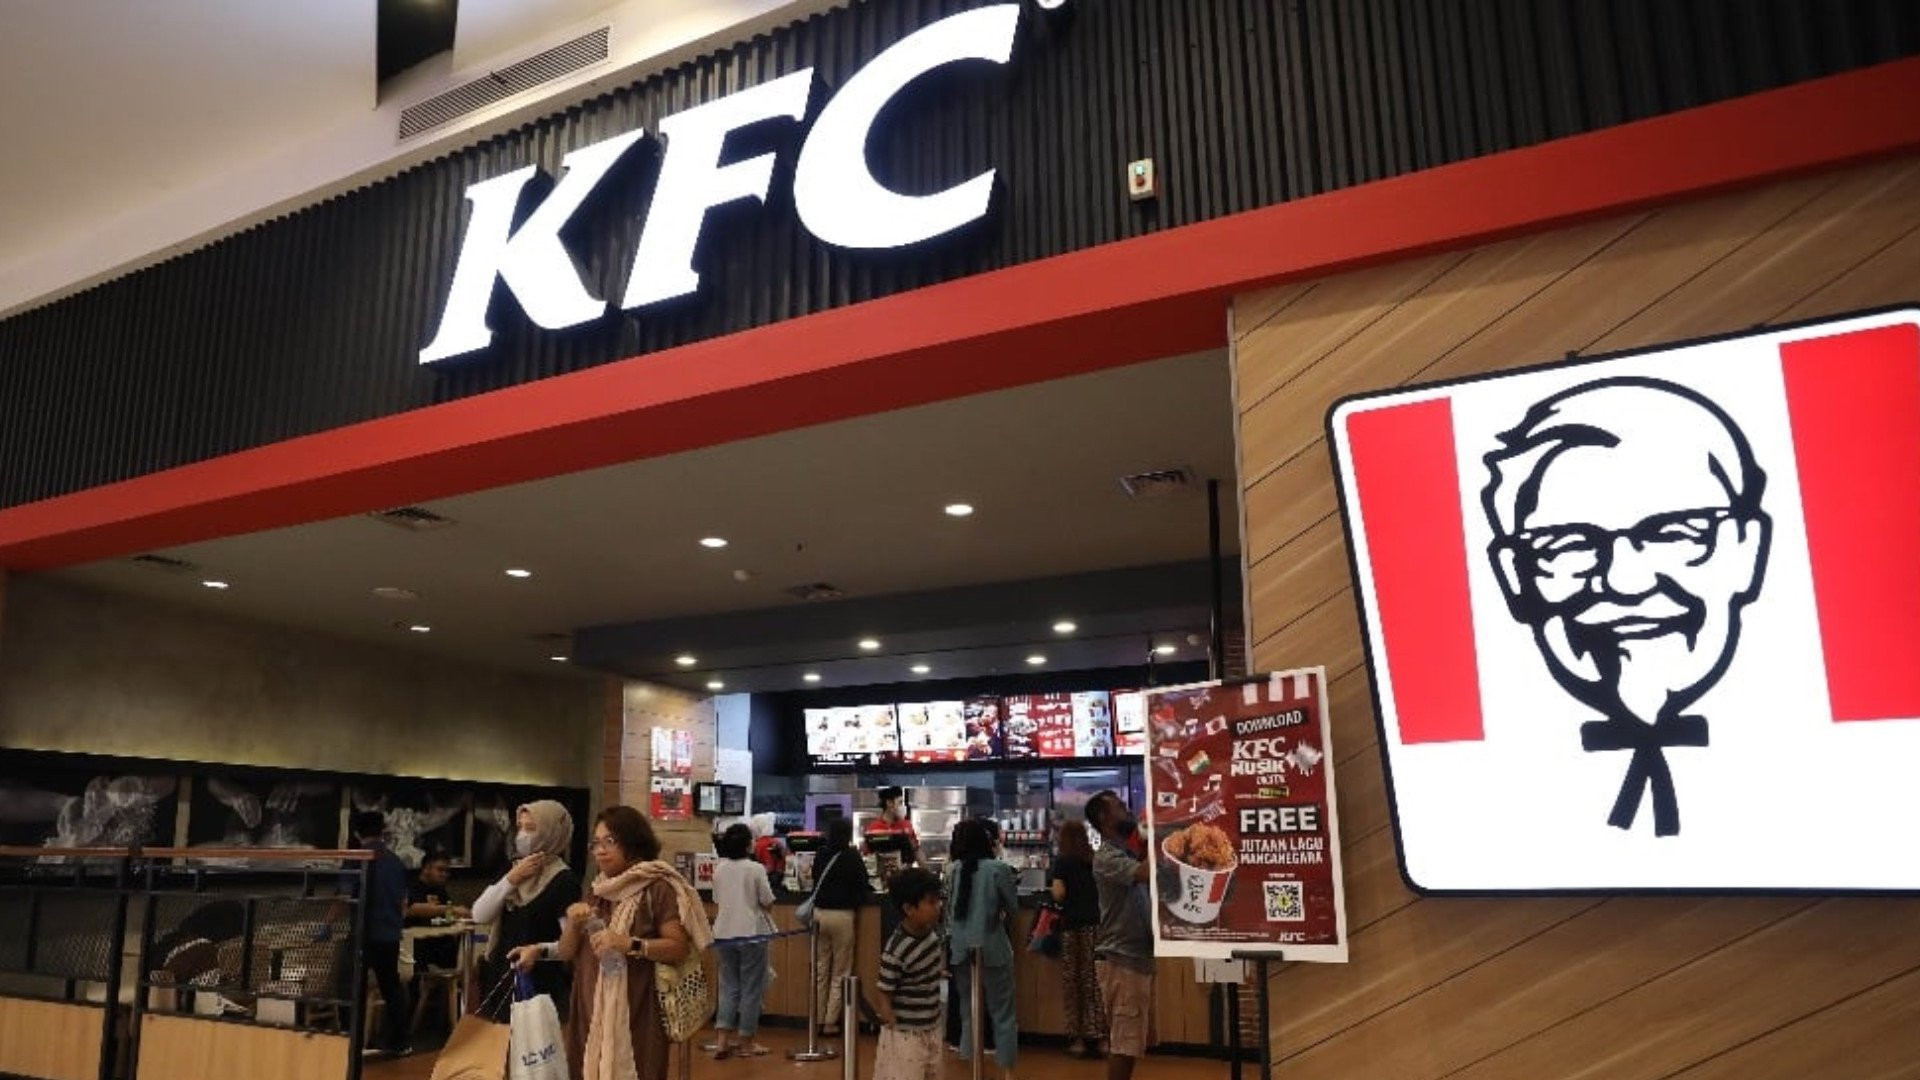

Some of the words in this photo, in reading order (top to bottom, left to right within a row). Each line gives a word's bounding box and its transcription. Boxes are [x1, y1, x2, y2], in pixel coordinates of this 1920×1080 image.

[419, 3, 1020, 364] KFC
[1236, 710, 1302, 735] DOWNLOAD
[1231, 737, 1286, 761] KFC
[1230, 760, 1286, 777] MUSIK
[1240, 806, 1317, 832] FREE
[1239, 839, 1288, 853] JUTAAN
[1290, 837, 1323, 851] LAGU
[1240, 852, 1323, 865] MANCANEGARA
[1279, 931, 1306, 942] KFC
